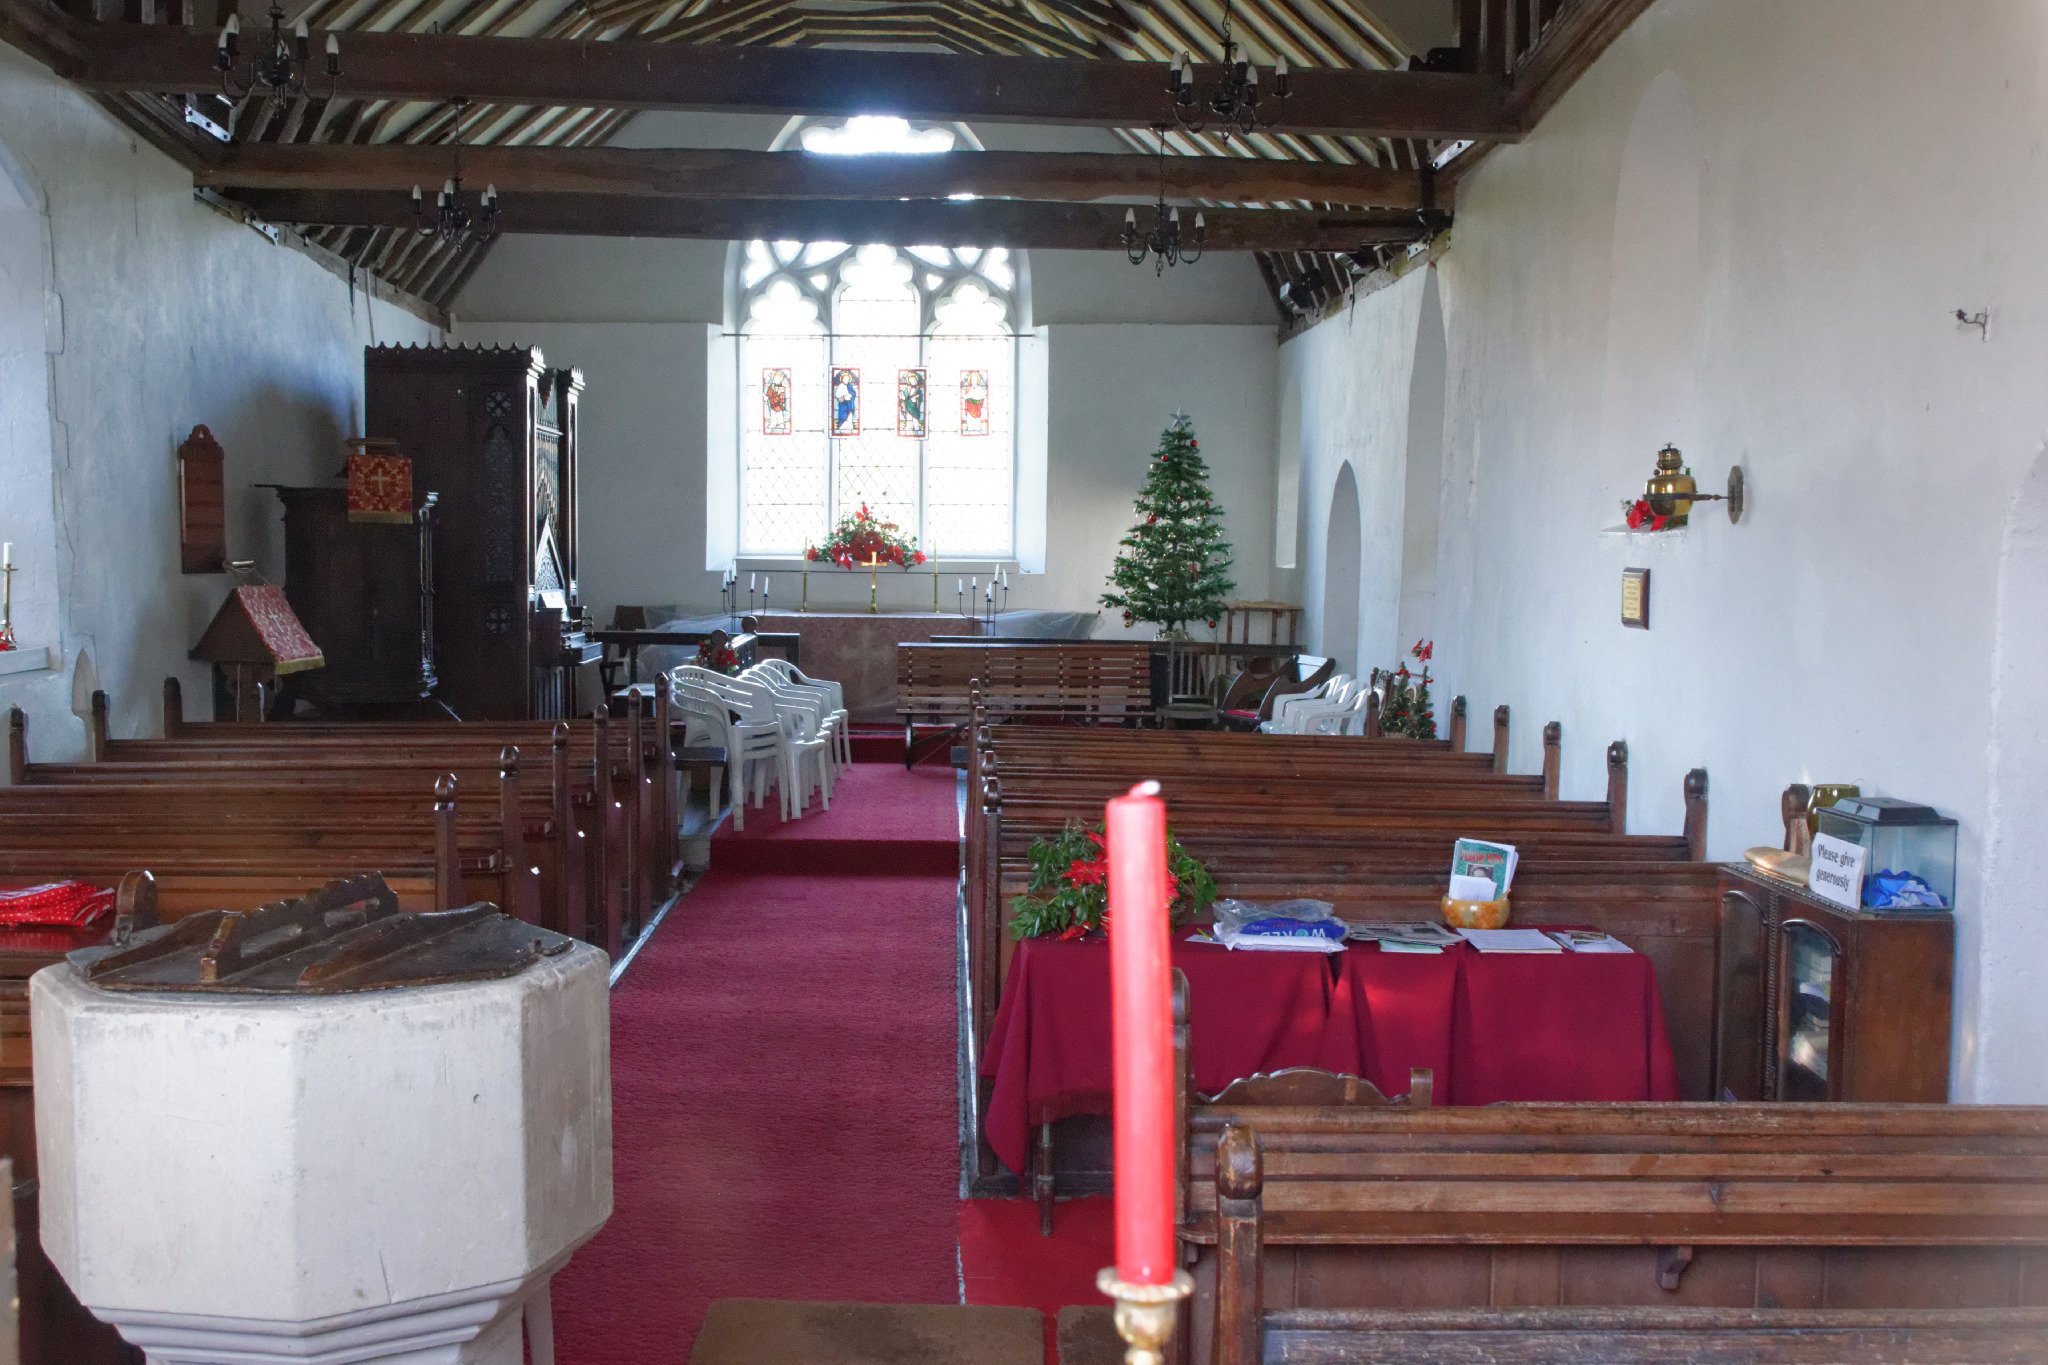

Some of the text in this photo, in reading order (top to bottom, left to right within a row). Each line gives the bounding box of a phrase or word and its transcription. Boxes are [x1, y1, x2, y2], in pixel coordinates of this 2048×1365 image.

[1817, 844, 1855, 868] Please give
[1816, 868, 1850, 891] generously
